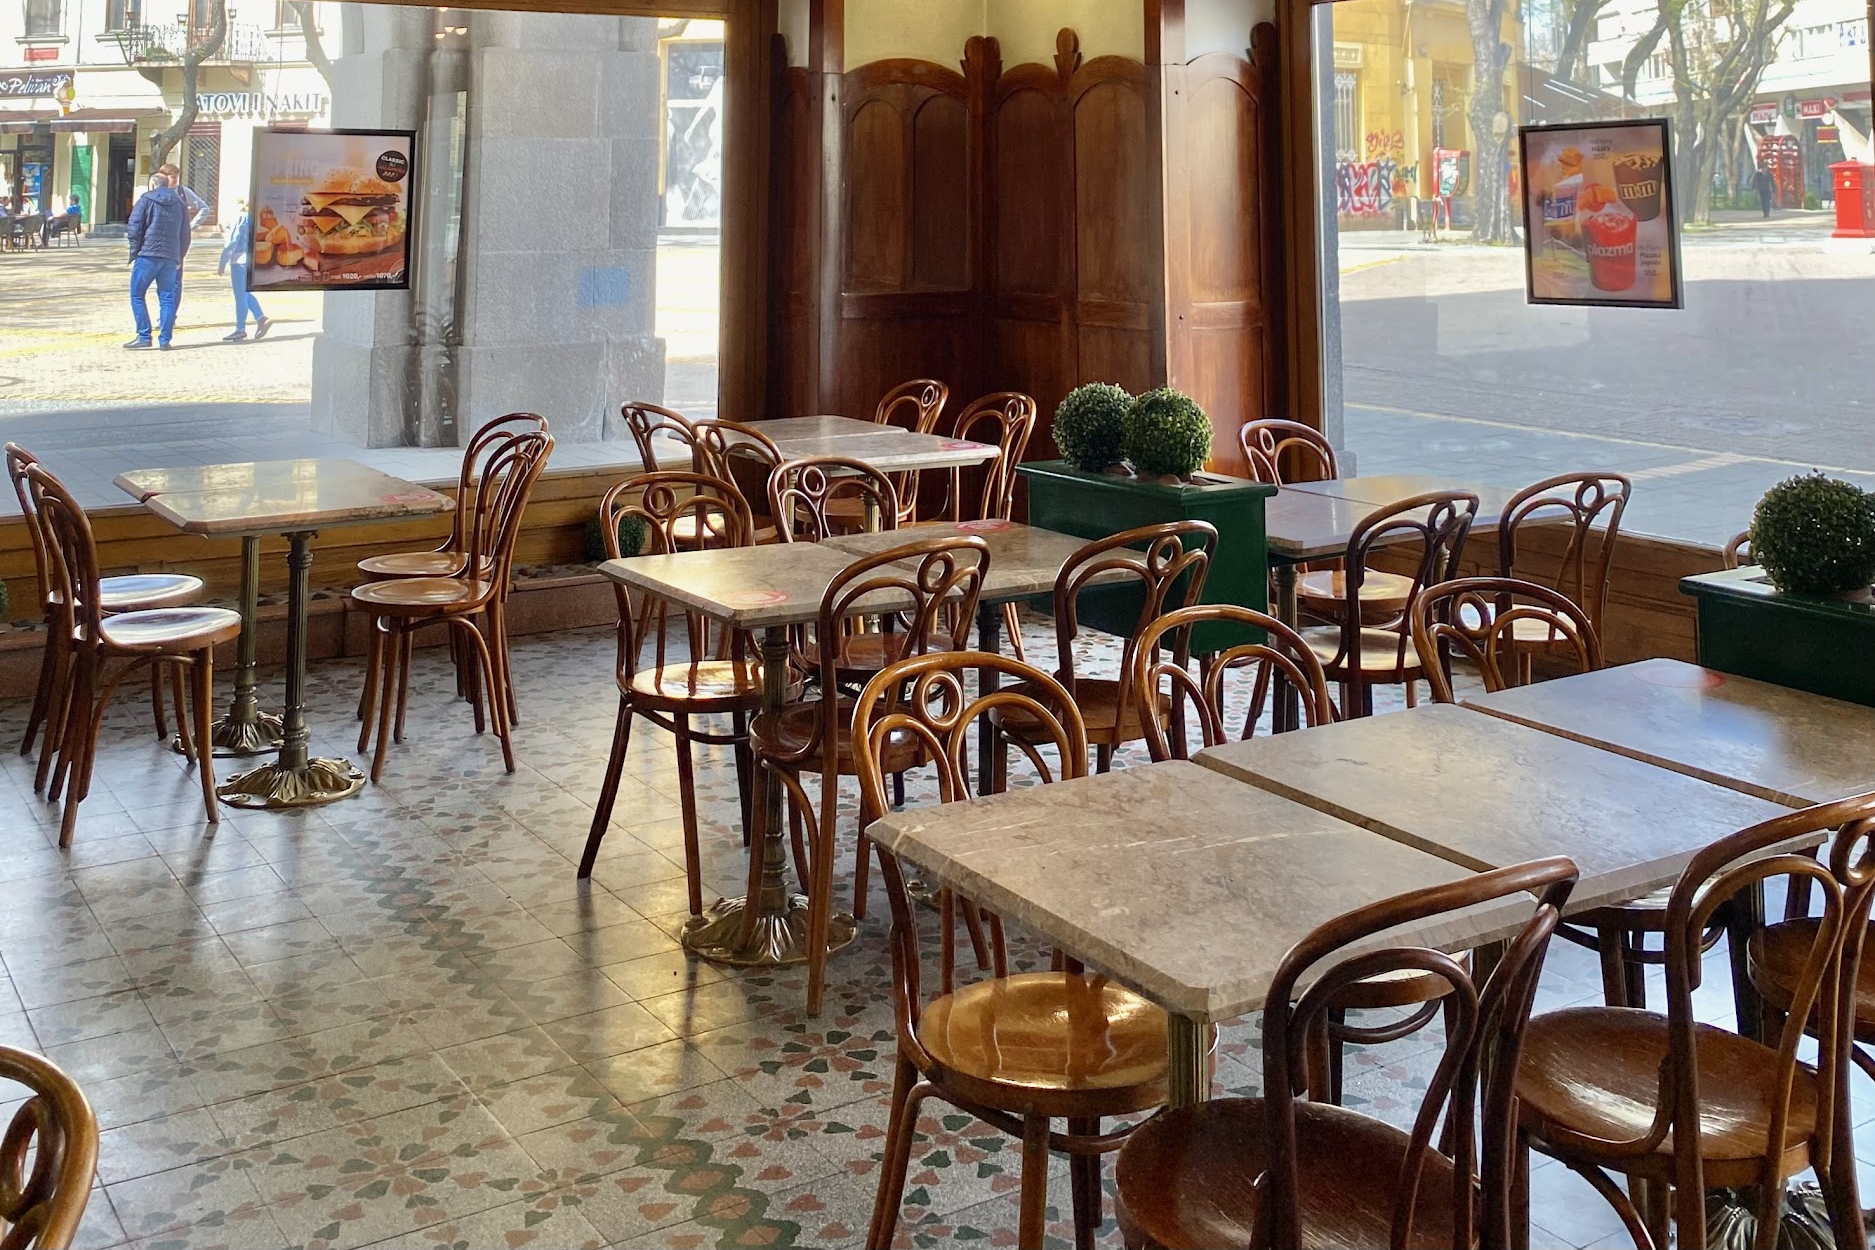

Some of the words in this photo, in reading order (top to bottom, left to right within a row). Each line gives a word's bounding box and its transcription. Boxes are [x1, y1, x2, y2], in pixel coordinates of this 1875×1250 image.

[8, 74, 51, 94] Pelivan
[195, 93, 247, 112] ATOVI
[265, 93, 323, 112] NAKIT
[1588, 242, 1634, 257] plazma
